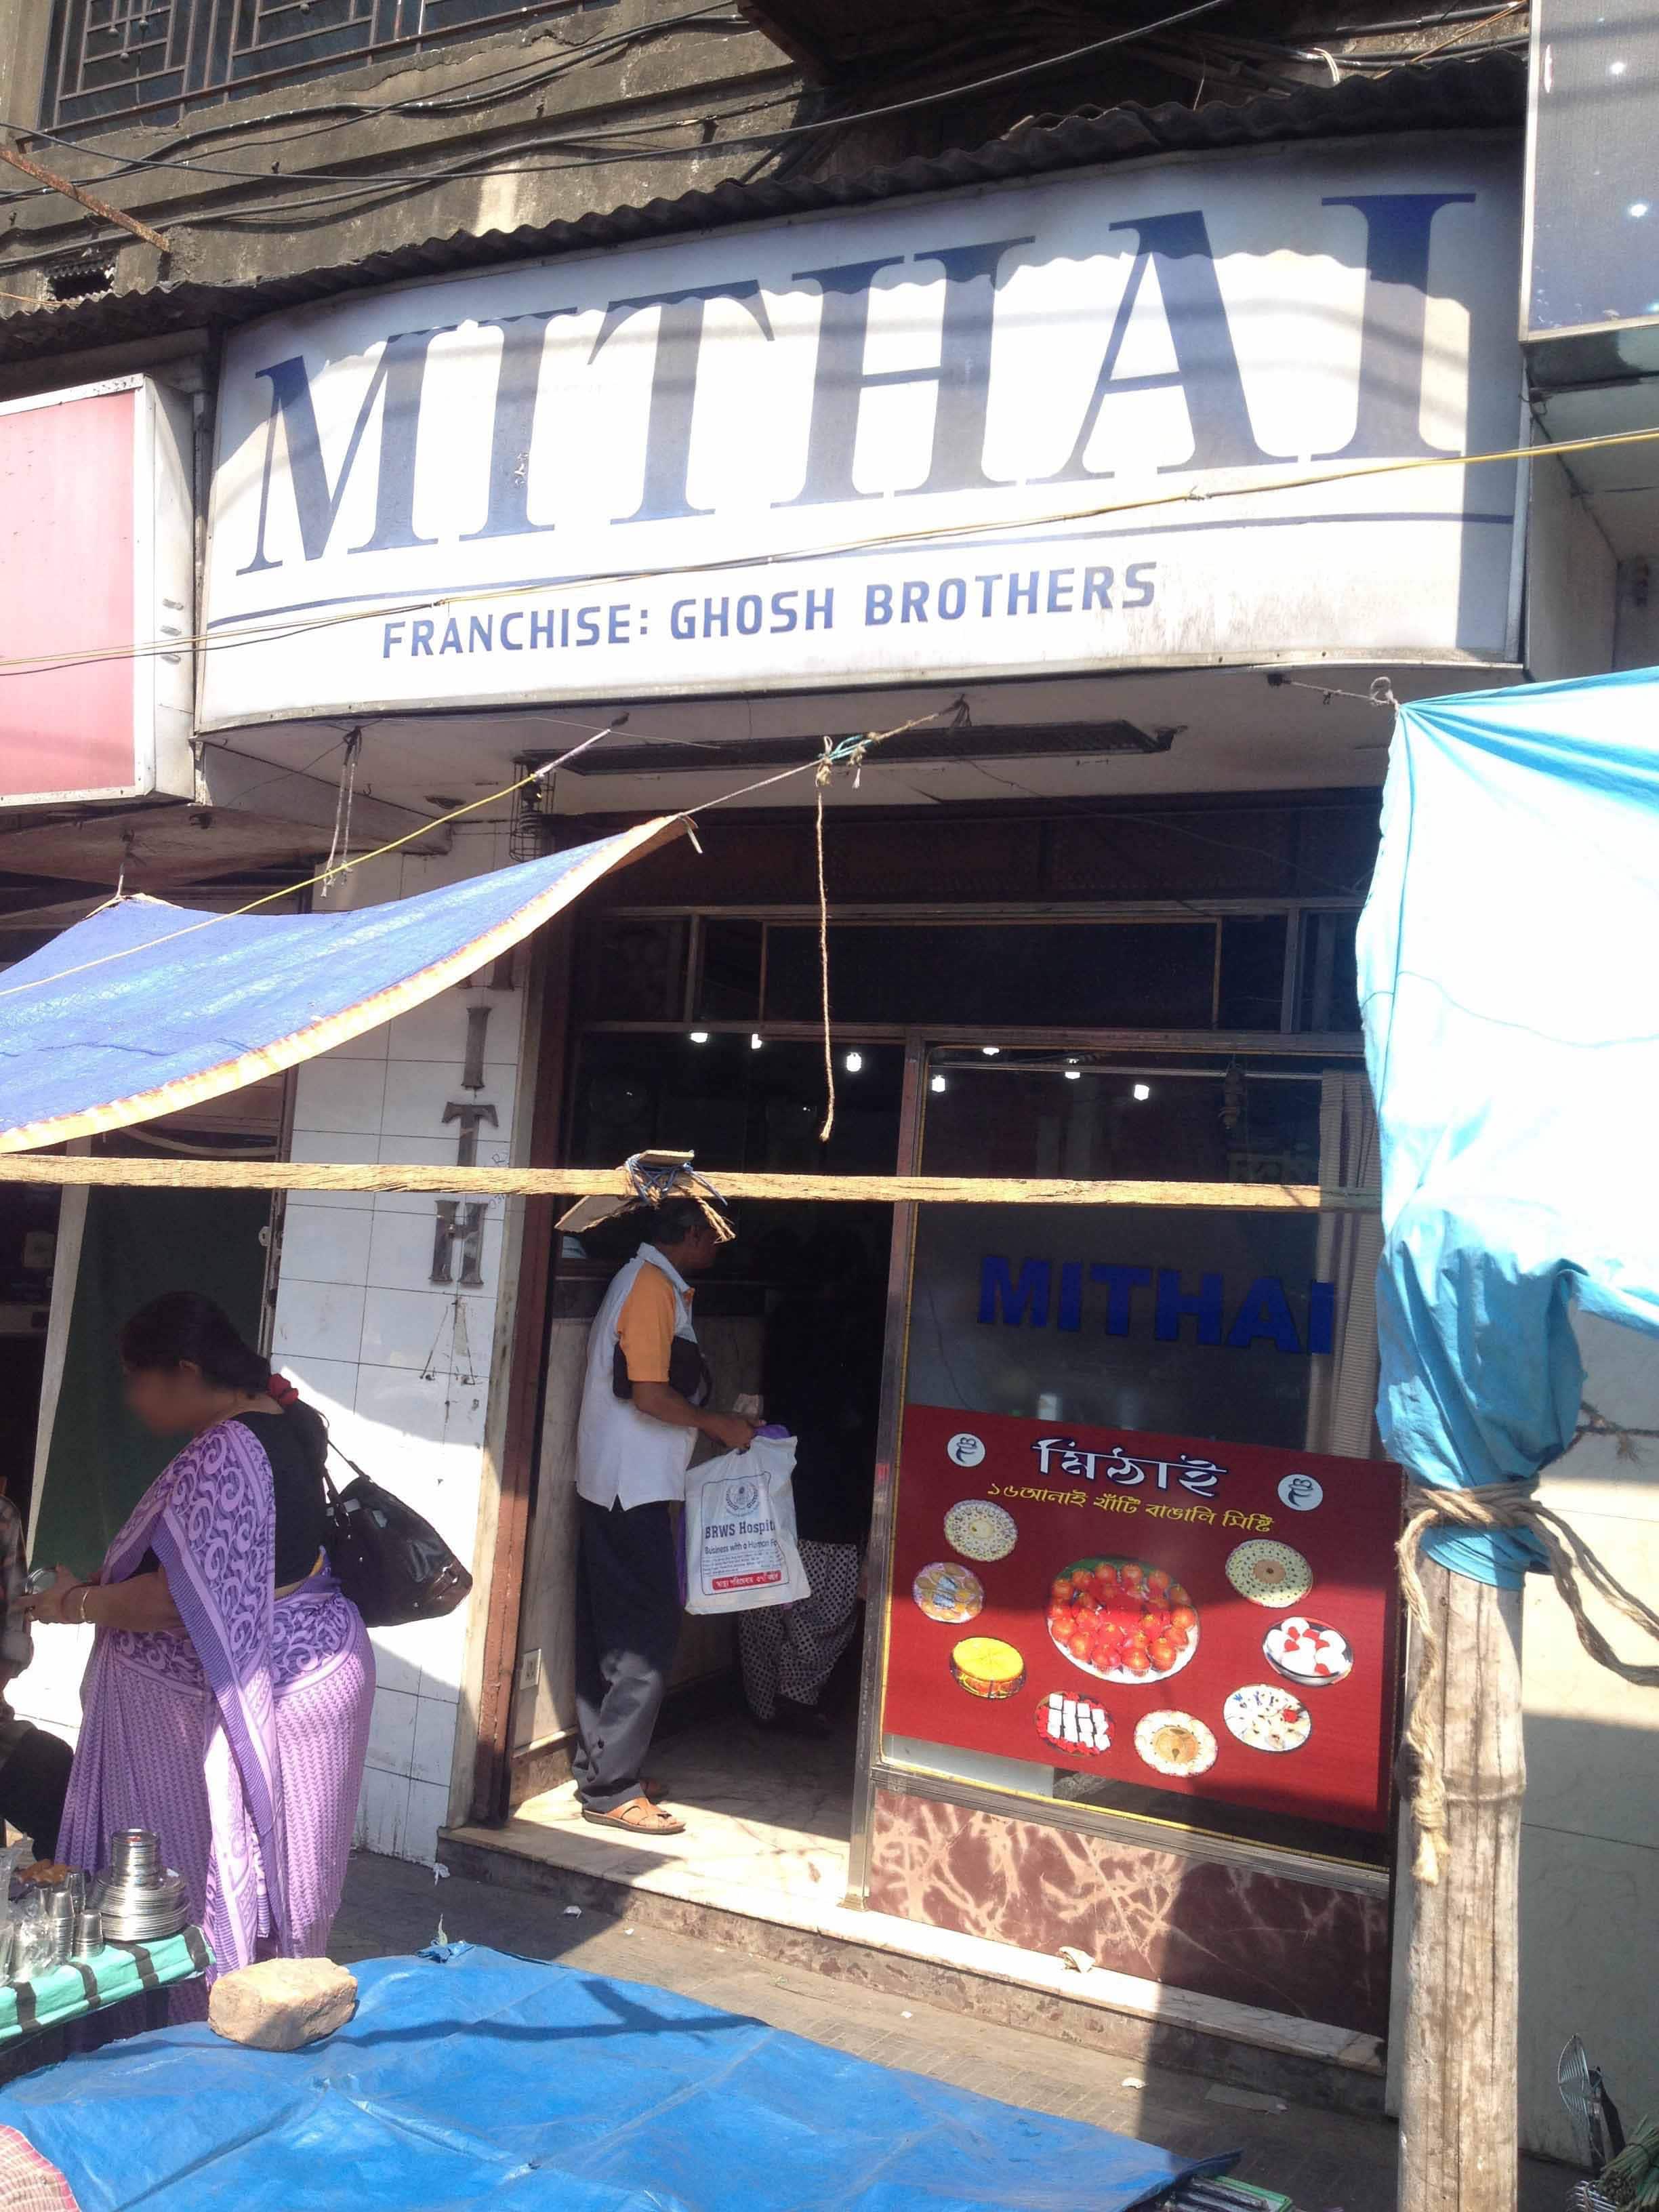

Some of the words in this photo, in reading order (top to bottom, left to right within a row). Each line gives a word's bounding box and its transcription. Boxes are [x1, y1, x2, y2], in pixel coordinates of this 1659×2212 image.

[237, 192, 1476, 576] MITHAI
[382, 603, 649, 659] FRANCHISE:
[670, 588, 834, 640] GHOSH
[864, 561, 1157, 627] BROTHERS
[977, 1255, 1335, 1355] MITHAI
[1031, 1438, 1228, 1497] মিঠাই
[705, 1523, 736, 1540] BRWS
[1222, 1509, 1275, 1533] মিষ্টি
